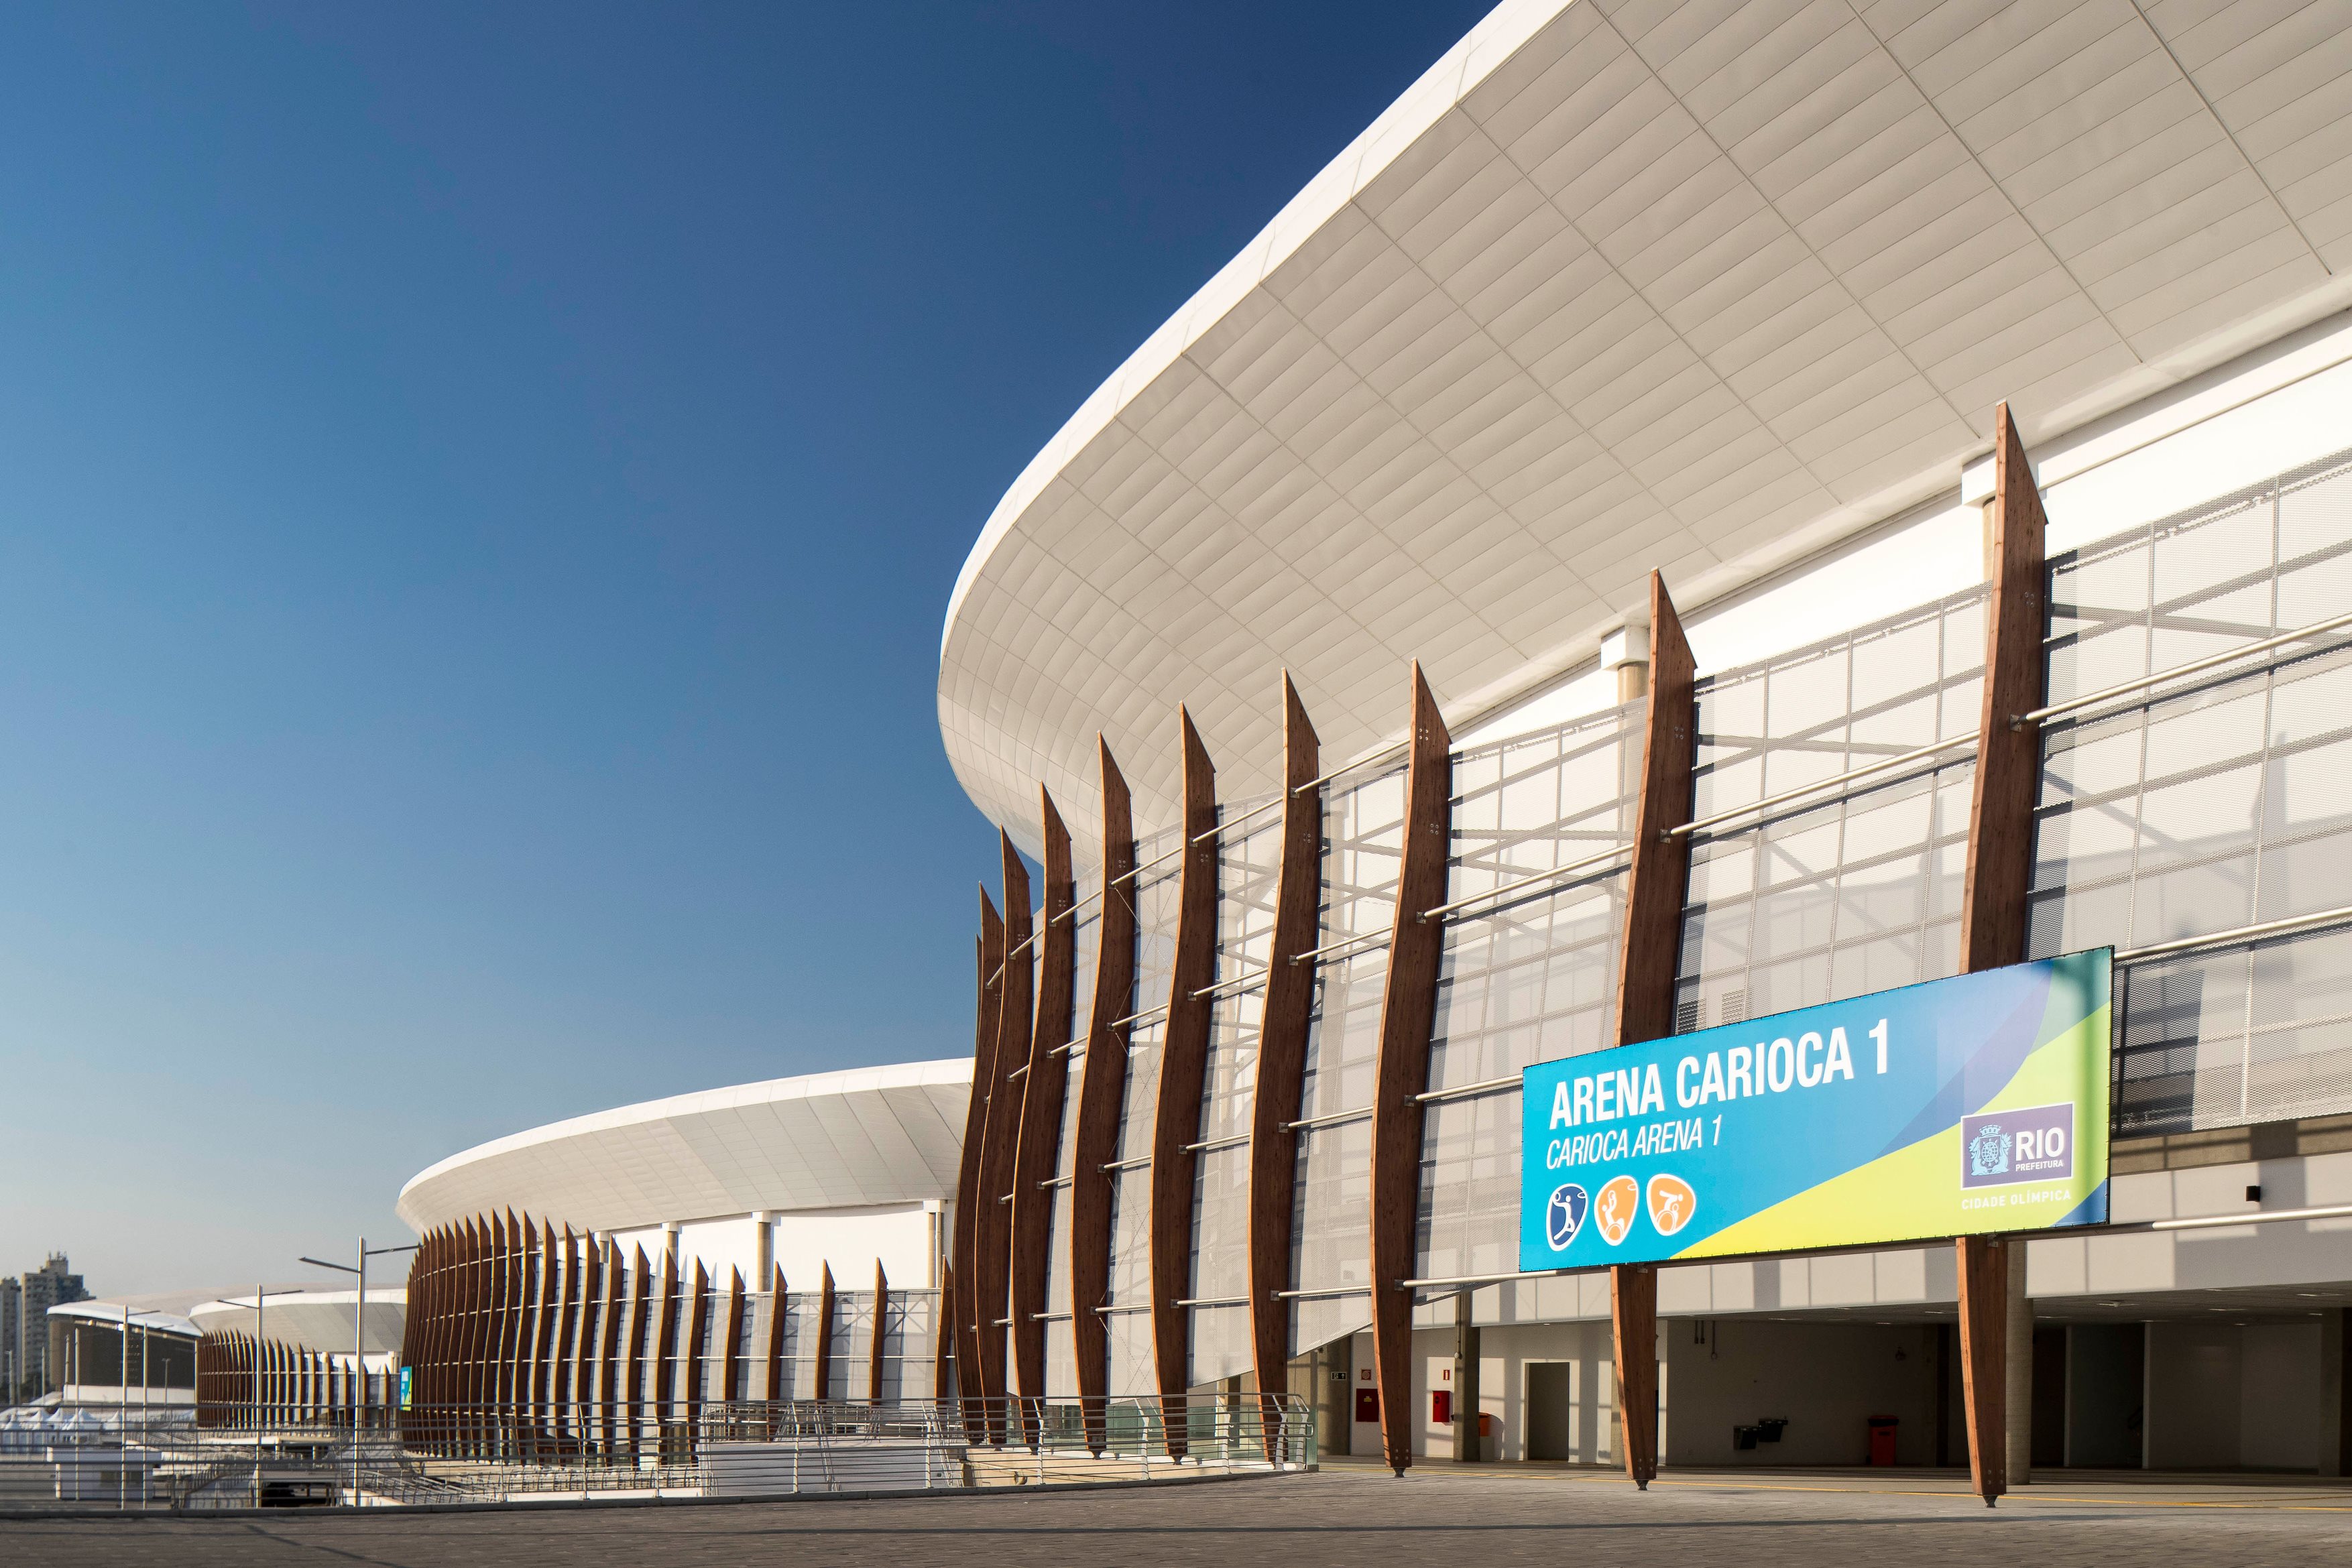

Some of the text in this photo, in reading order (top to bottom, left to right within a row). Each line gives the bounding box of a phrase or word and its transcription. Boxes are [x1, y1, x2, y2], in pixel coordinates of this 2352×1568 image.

[1549, 1018, 1887, 1130] ARENA CARIOCA 1
[1546, 1114, 1722, 1170] CARIOCA ARENA 1
[2015, 1127, 2064, 1162] RIO
[2015, 1160, 2064, 1172] PREFEITURA
[1961, 1189, 2072, 1210] CIDADE OLÍMPICA
